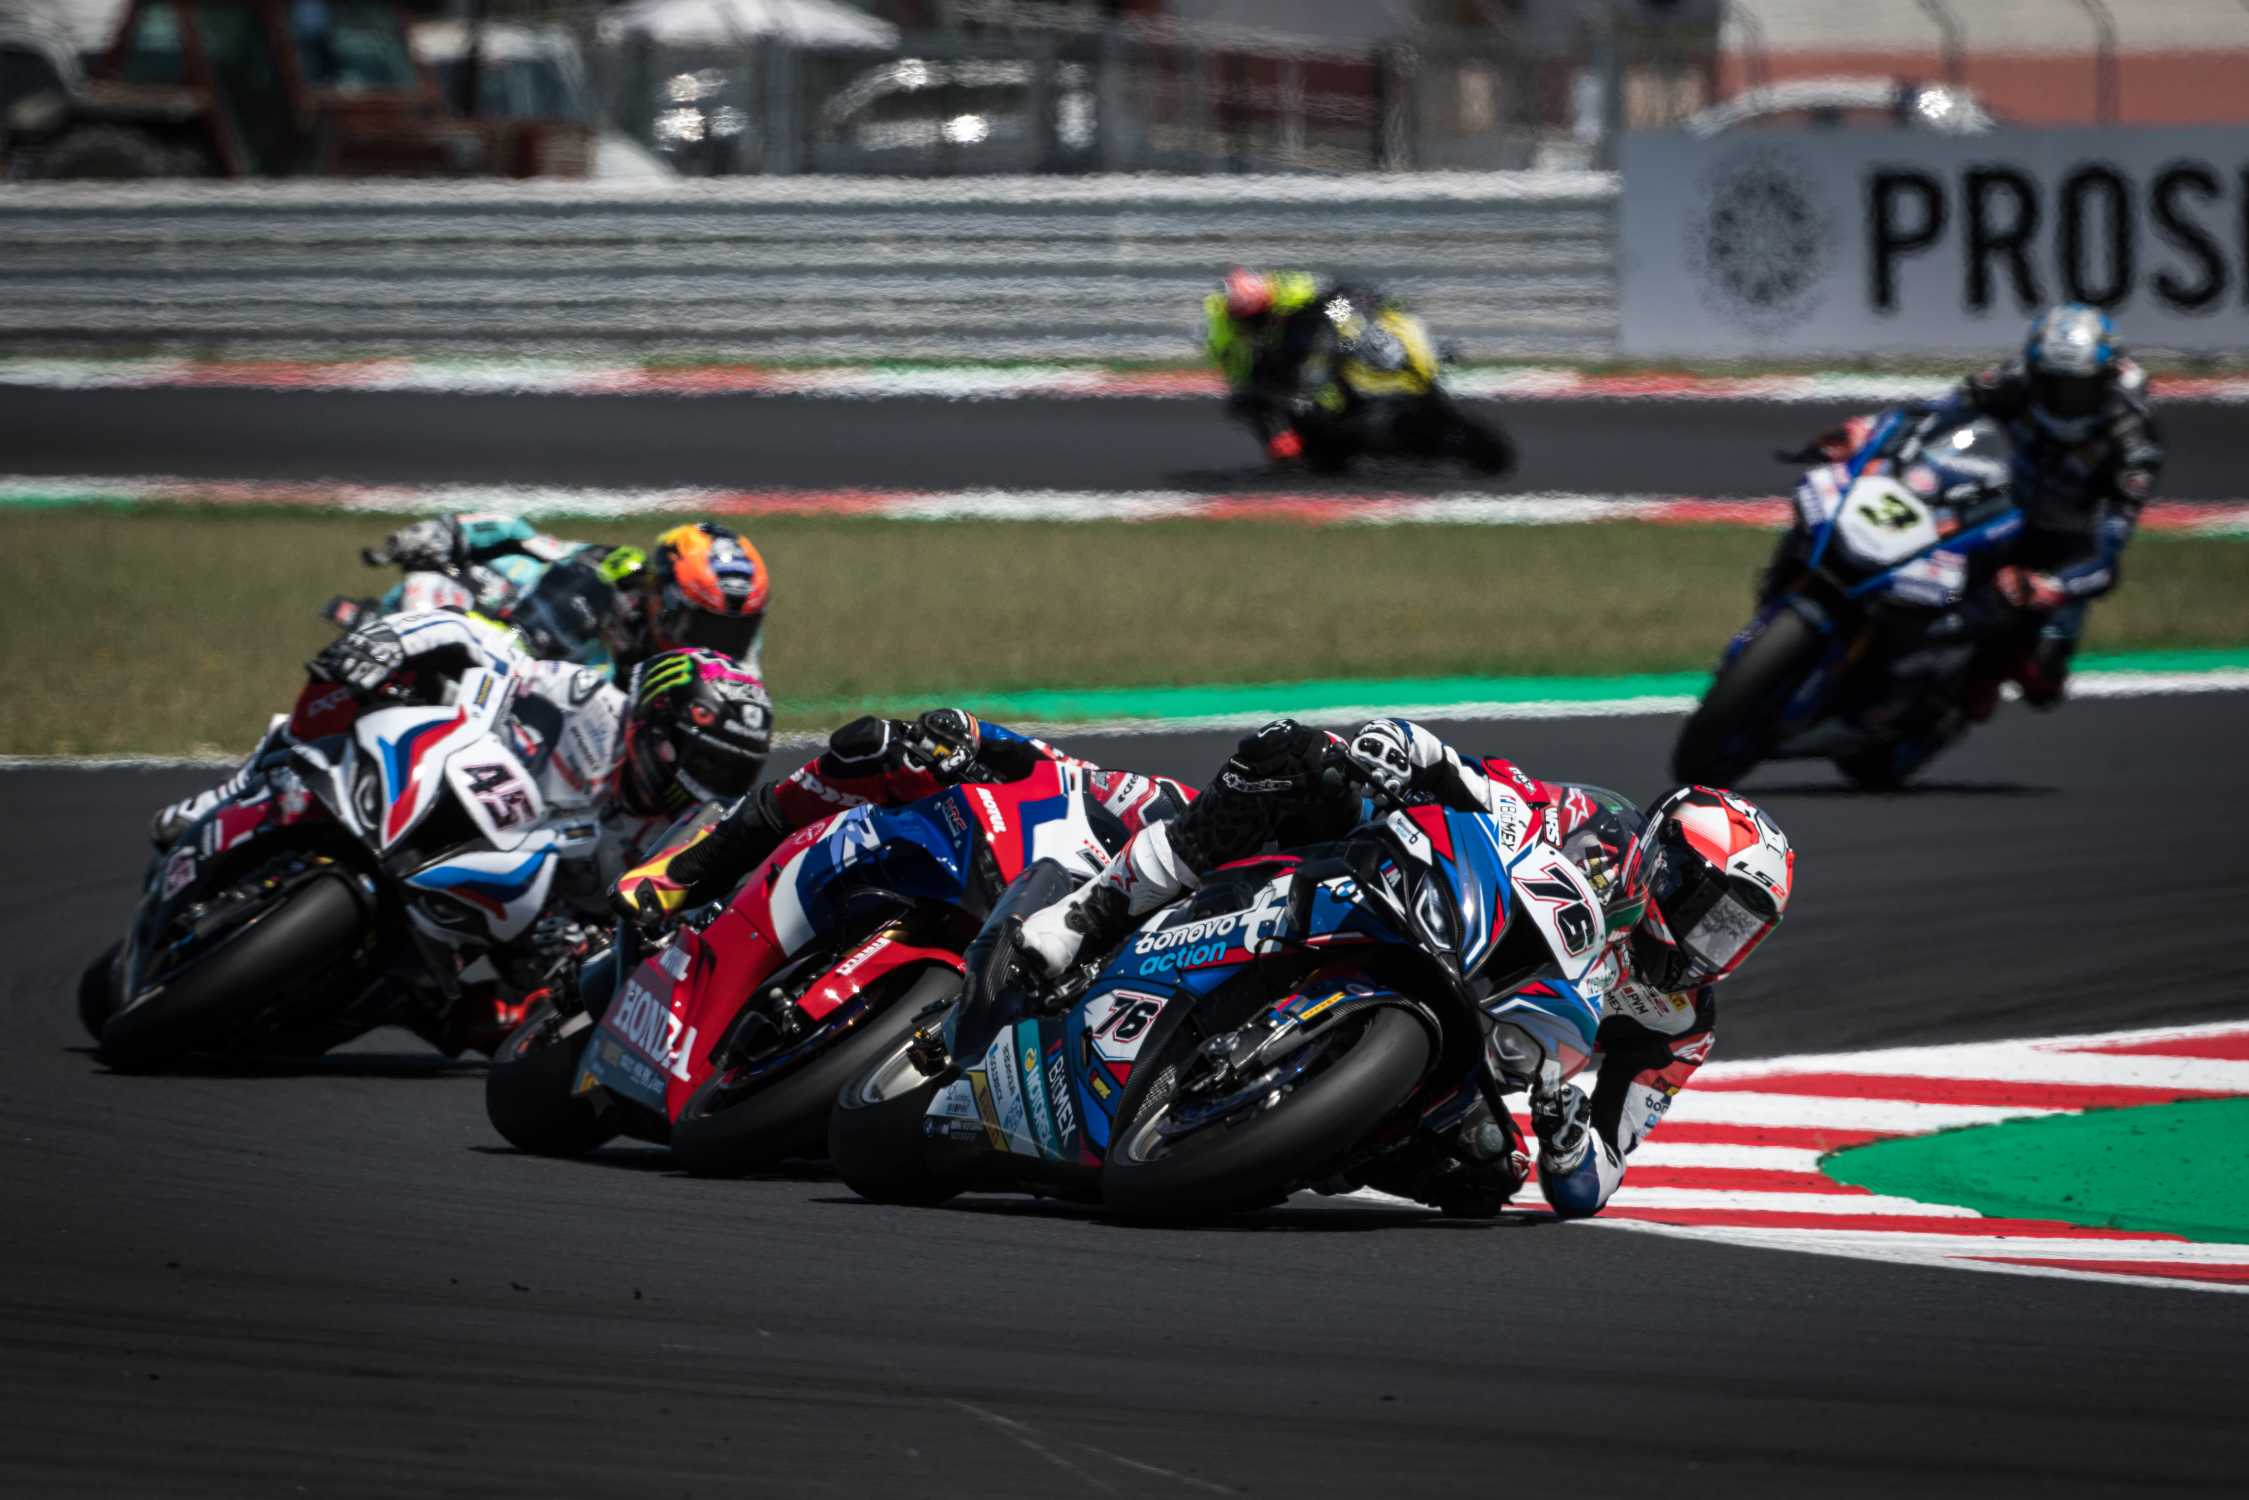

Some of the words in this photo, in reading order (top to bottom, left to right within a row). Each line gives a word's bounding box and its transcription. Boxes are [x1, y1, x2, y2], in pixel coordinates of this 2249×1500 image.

[1866, 160, 2249, 312] PROS
[462, 763, 536, 832] 45
[1733, 861, 1786, 900] LS2
[1135, 916, 1236, 954] bonovo
[1511, 863, 1597, 957] 76
[1139, 941, 1227, 976] action
[612, 978, 698, 1082] HONDA
[1092, 992, 1163, 1043] 76
[1645, 1094, 1671, 1113] bon
